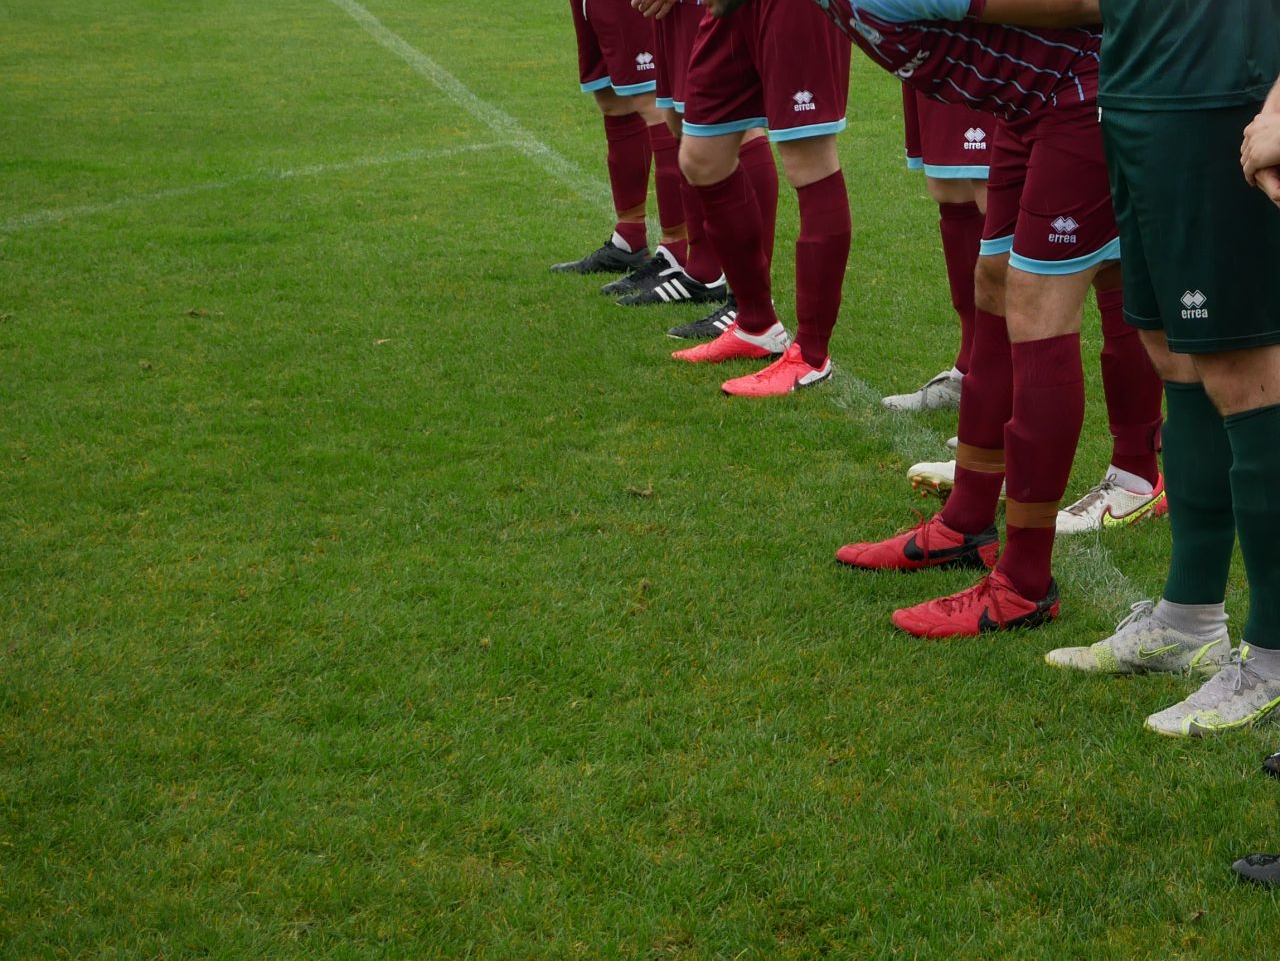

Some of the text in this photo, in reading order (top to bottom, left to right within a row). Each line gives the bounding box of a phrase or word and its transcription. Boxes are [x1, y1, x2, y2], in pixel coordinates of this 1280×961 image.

[963, 141, 987, 150] errea
[1048, 233, 1077, 244] errea
[1181, 308, 1209, 319] errea
